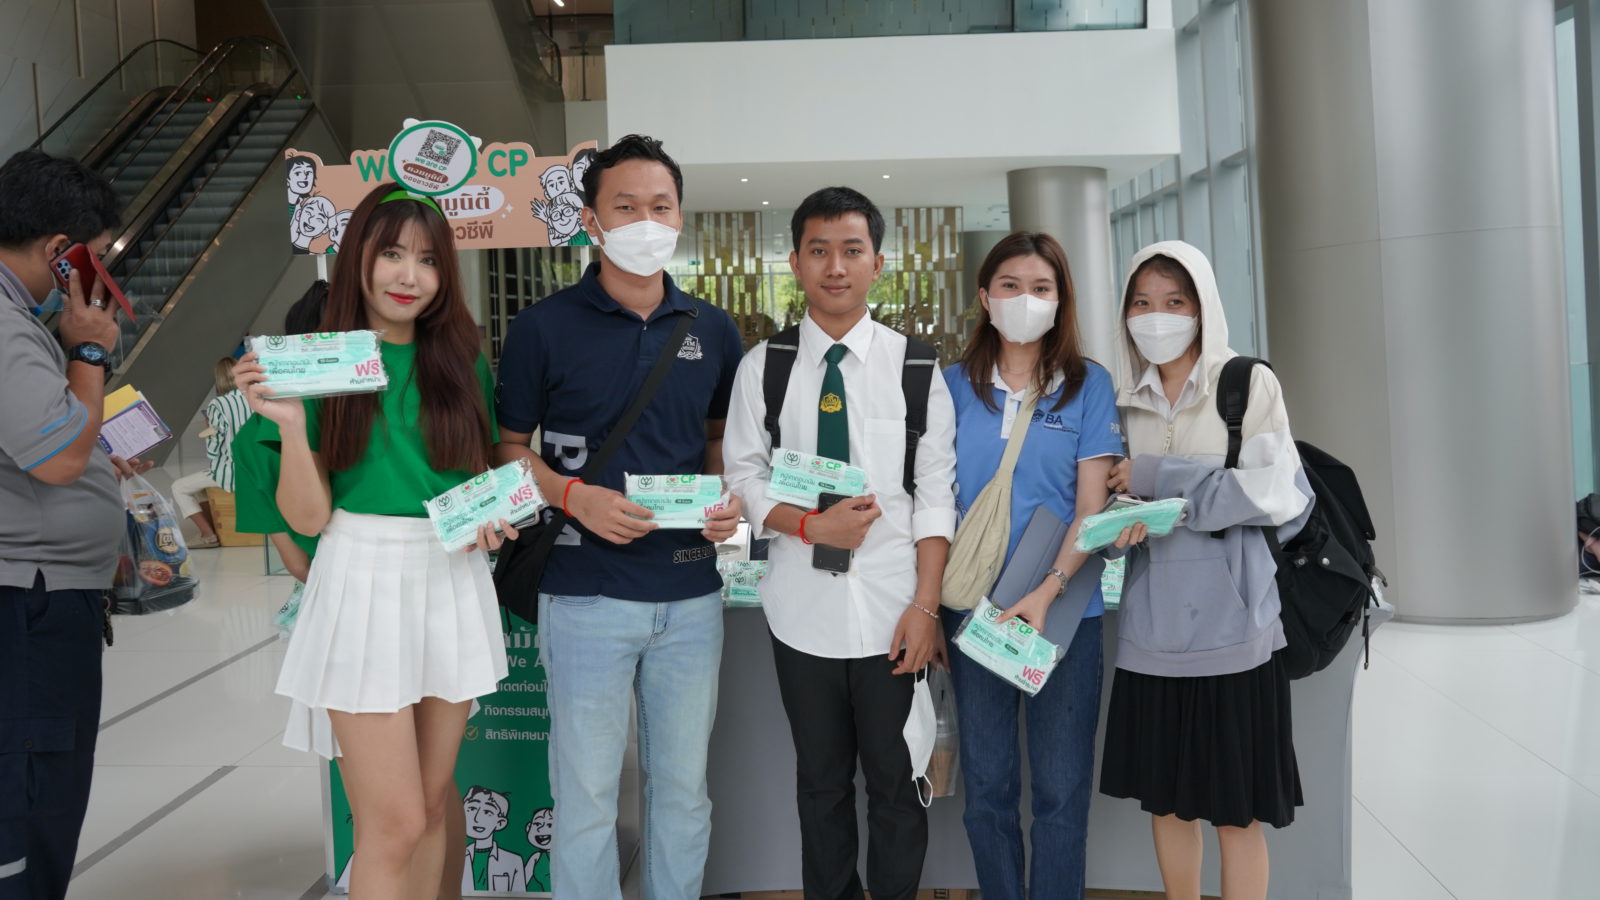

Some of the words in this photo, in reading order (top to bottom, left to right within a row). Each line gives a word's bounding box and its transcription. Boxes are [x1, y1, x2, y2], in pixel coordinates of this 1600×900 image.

[356, 155, 387, 182] W
[487, 148, 529, 177] CP
[456, 220, 494, 241] วซีพี
[355, 359, 381, 377] ฟรี
[1045, 413, 1063, 426] BA
[825, 461, 842, 471] CP
[474, 472, 490, 486] CP
[680, 474, 697, 484] CP
[509, 484, 534, 506] ฟรี
[672, 547, 702, 564] SINCE
[1018, 623, 1034, 635] CP
[1022, 665, 1046, 686] ฟรี
[485, 728, 549, 741] สิทธิพิเศษมา
